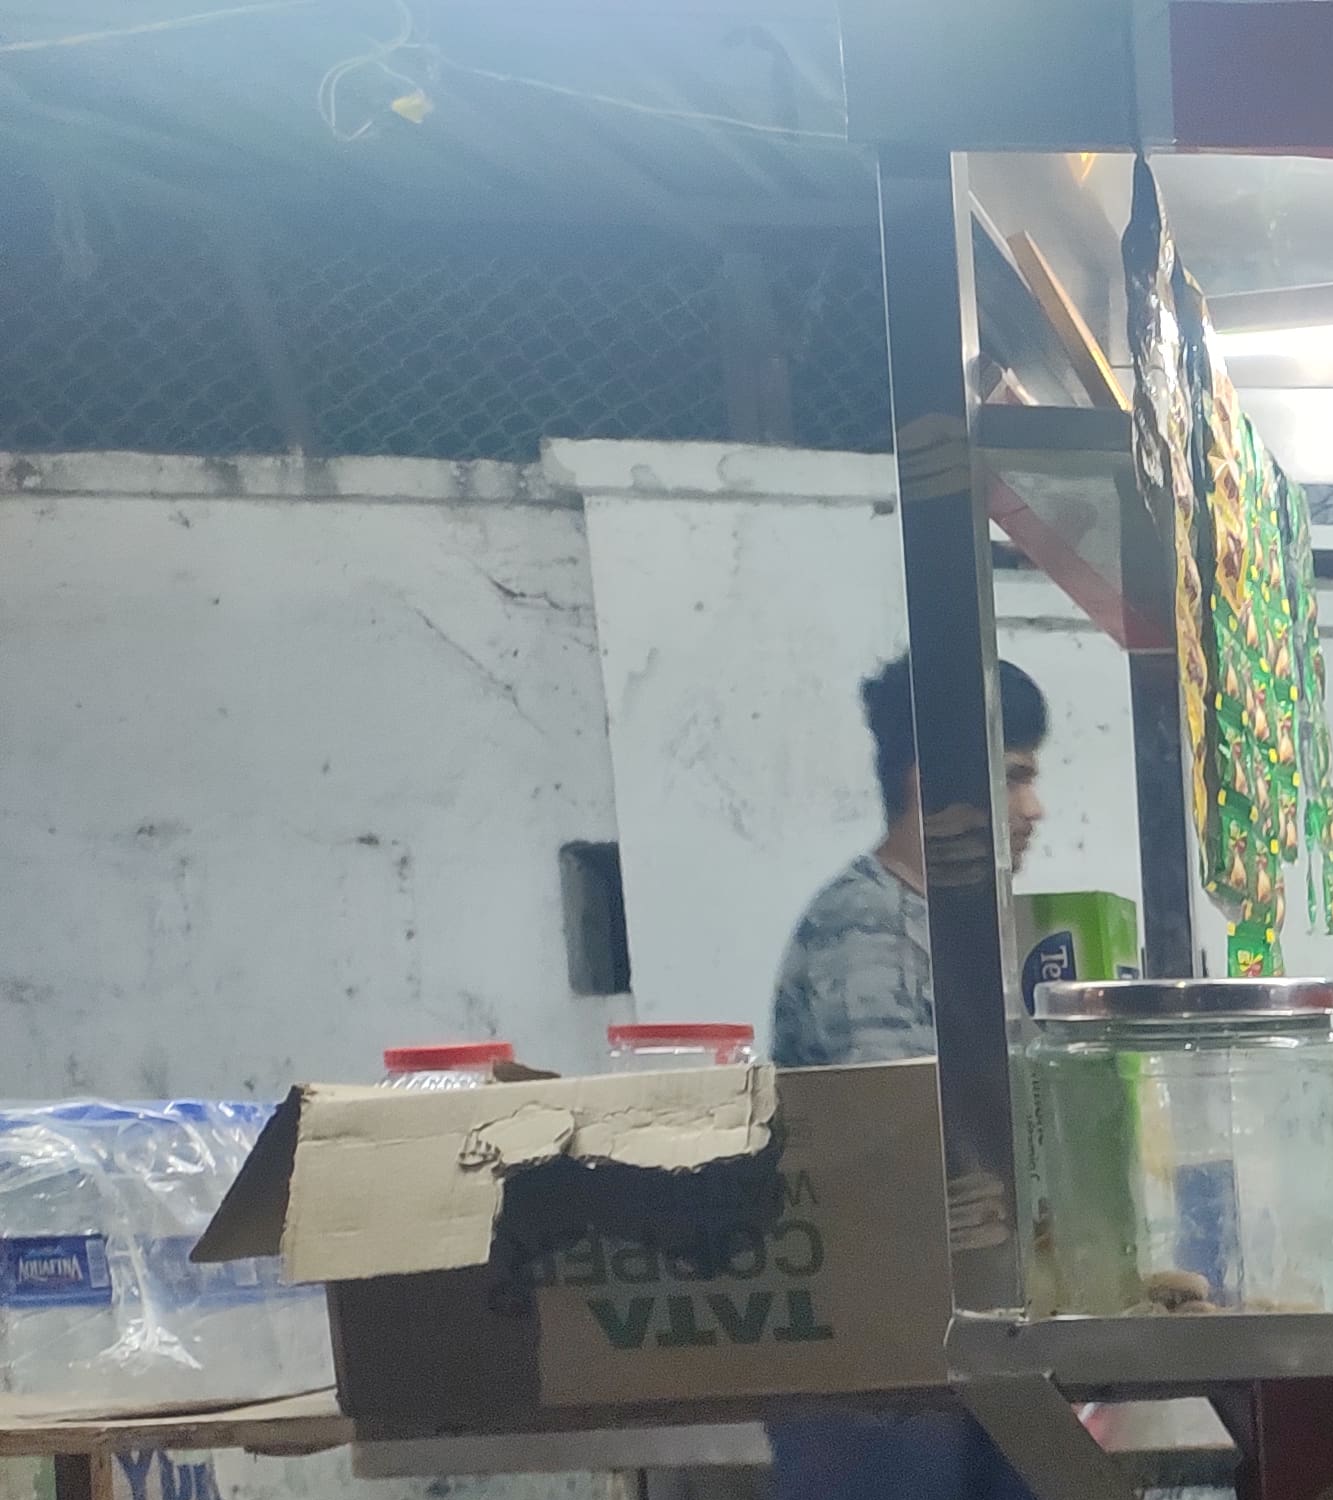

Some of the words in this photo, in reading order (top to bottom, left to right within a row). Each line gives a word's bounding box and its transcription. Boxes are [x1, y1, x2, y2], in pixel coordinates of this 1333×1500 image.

[1041, 945, 1069, 981] Te
[19, 1254, 83, 1283] AQUAFINA
[587, 1290, 834, 1350] TATA
